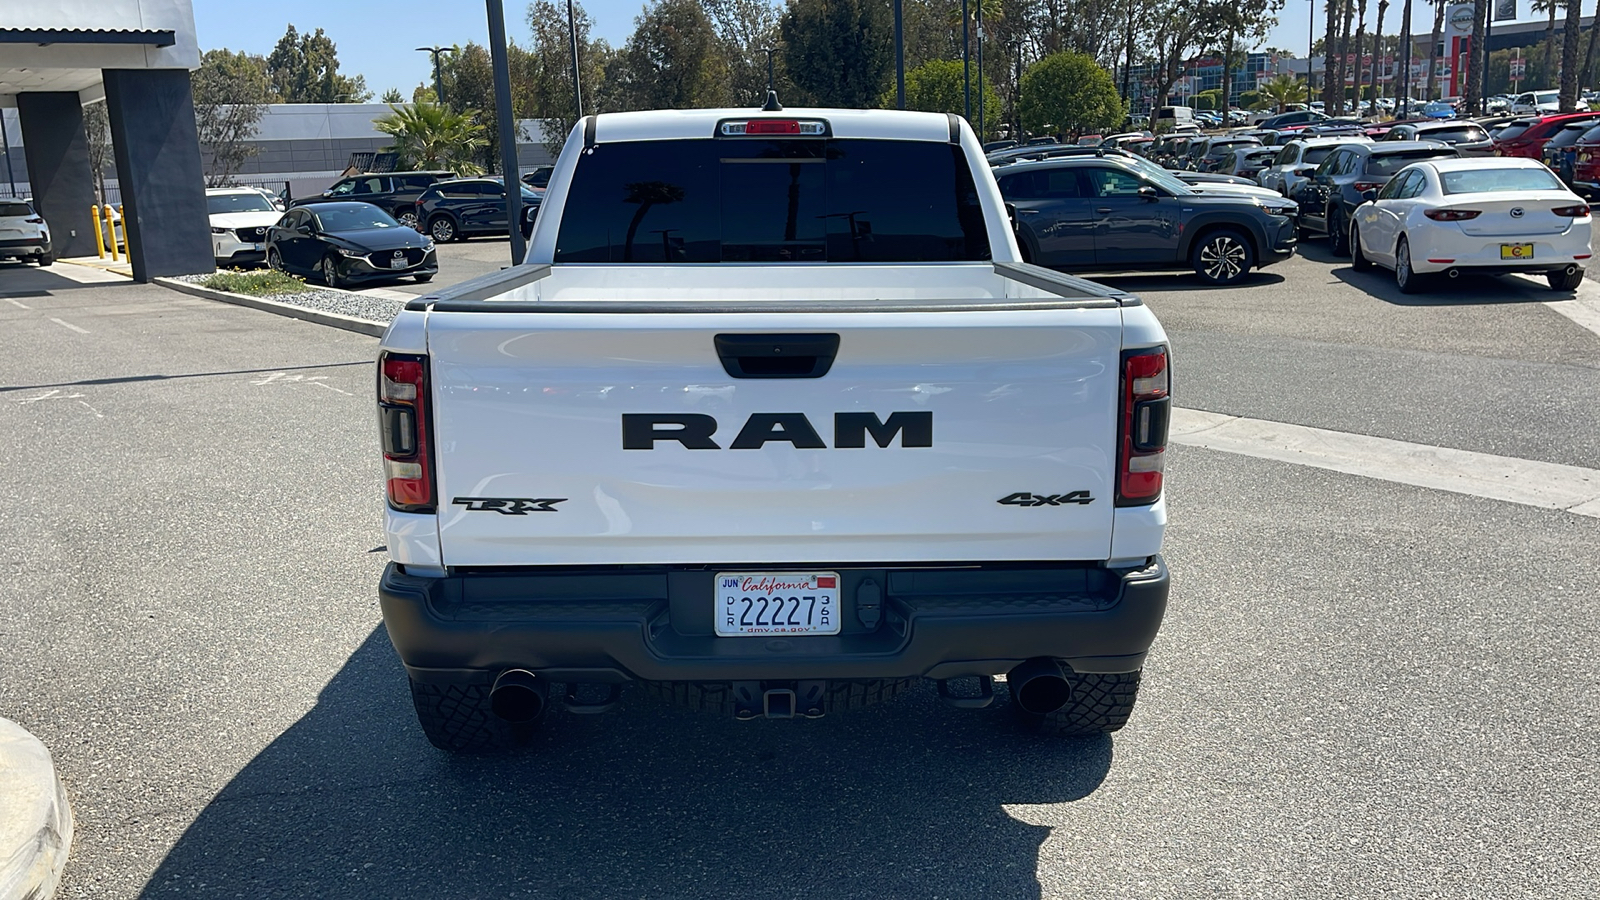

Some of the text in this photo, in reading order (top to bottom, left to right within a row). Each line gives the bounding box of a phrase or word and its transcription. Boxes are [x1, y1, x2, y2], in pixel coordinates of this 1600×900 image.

[622, 411, 933, 450] RAM
[452, 497, 568, 515] TRX
[996, 490, 1096, 507] 4x4
[722, 579, 738, 588] JUN
[741, 577, 818, 595] California
[727, 596, 735, 626] DLR
[740, 596, 816, 626] 22227
[820, 595, 830, 626] 36A
